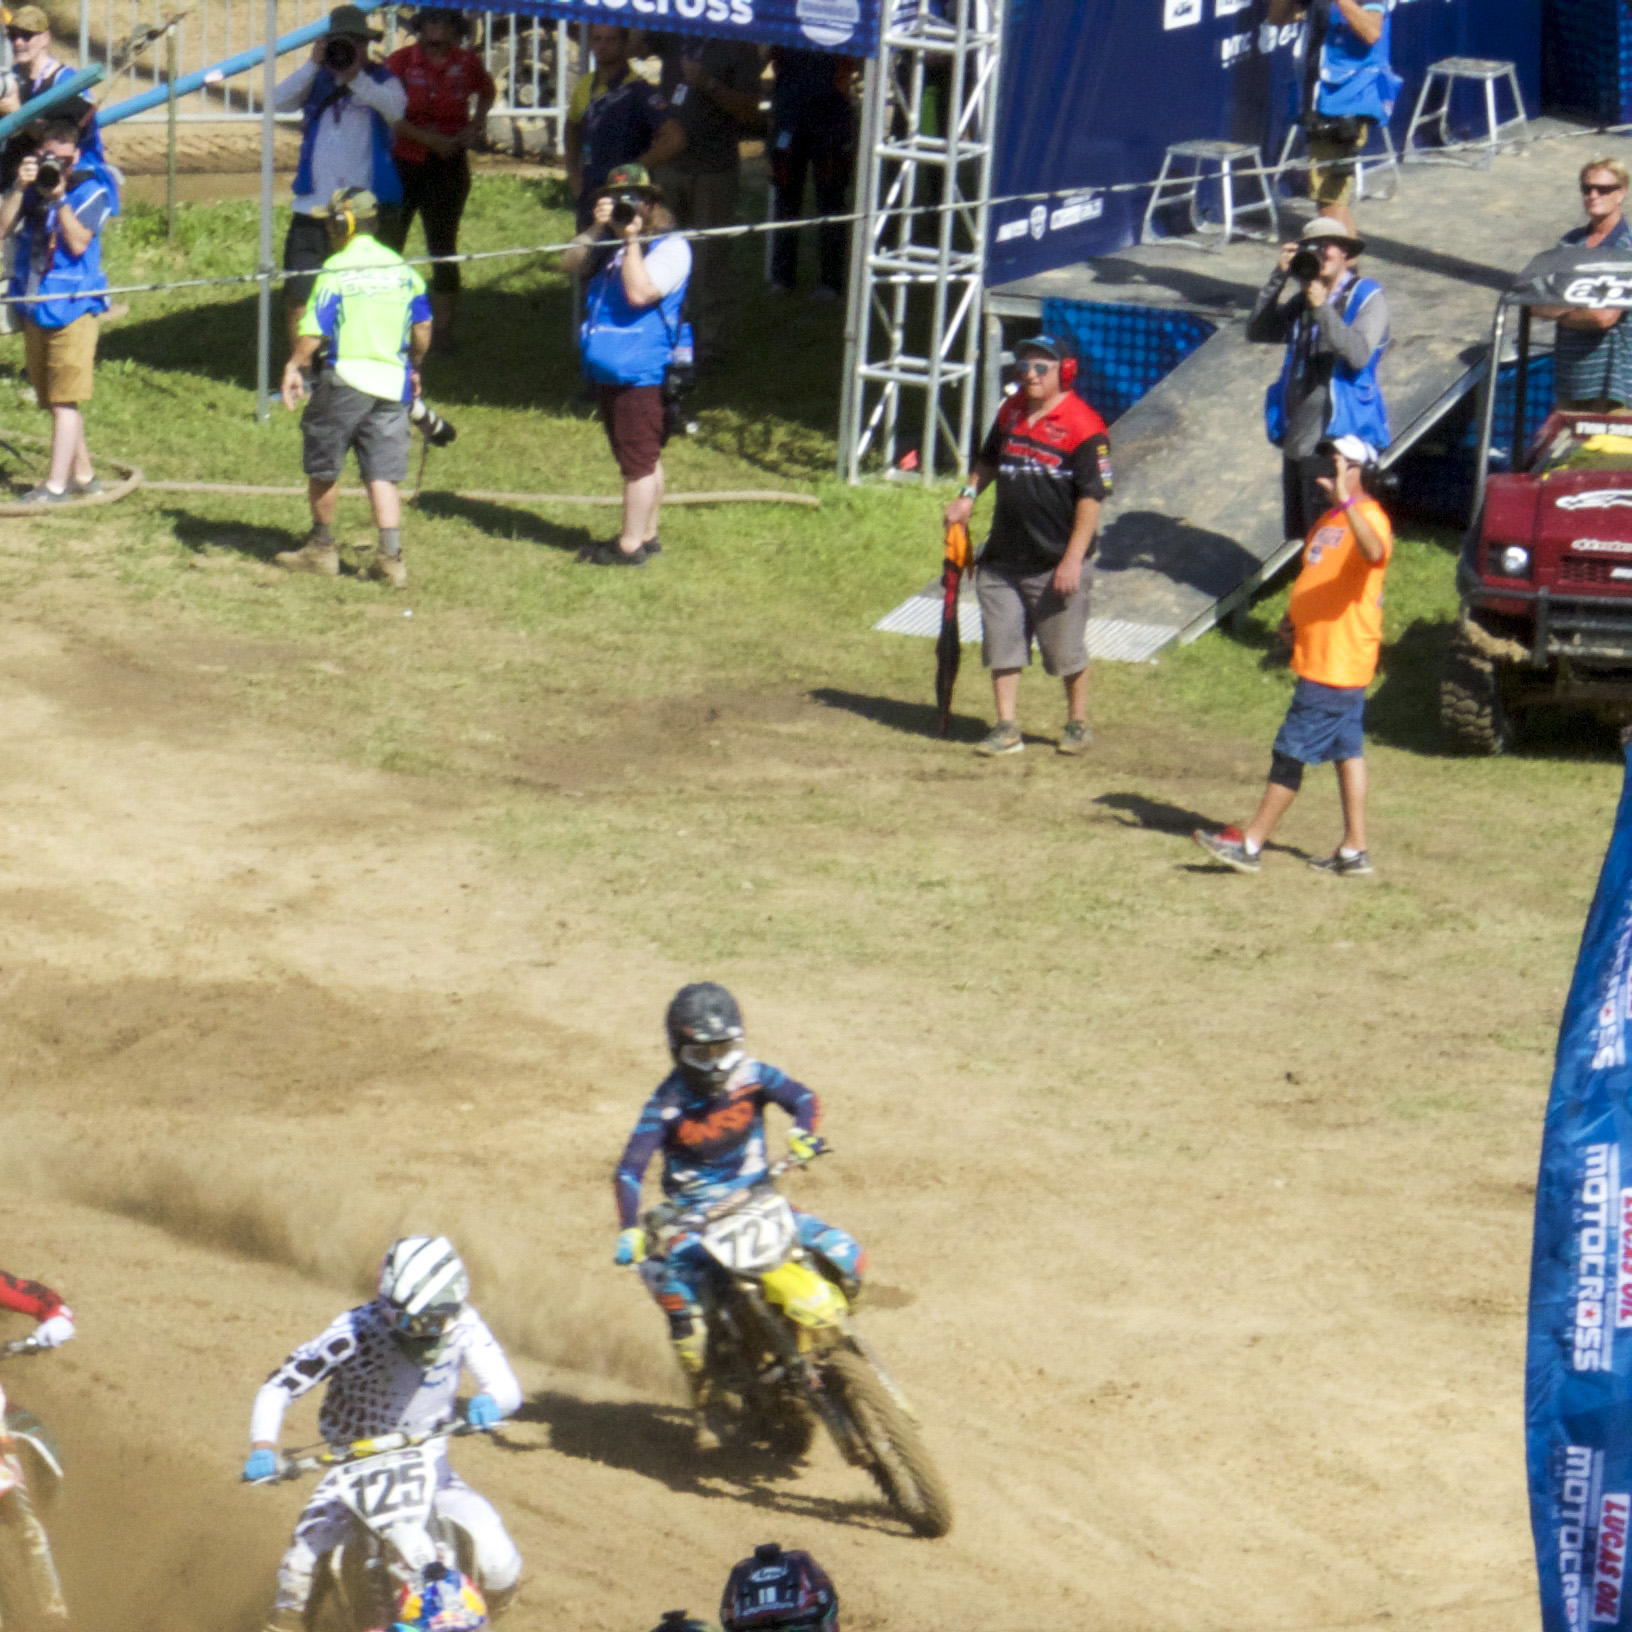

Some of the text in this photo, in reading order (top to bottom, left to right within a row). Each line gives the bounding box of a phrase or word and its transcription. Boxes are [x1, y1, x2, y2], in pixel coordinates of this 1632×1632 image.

[1572, 1143, 1610, 1373] MOTOCROSS
[347, 1466, 431, 1520] 125
[1594, 1500, 1628, 1621] LUCAS OIL
